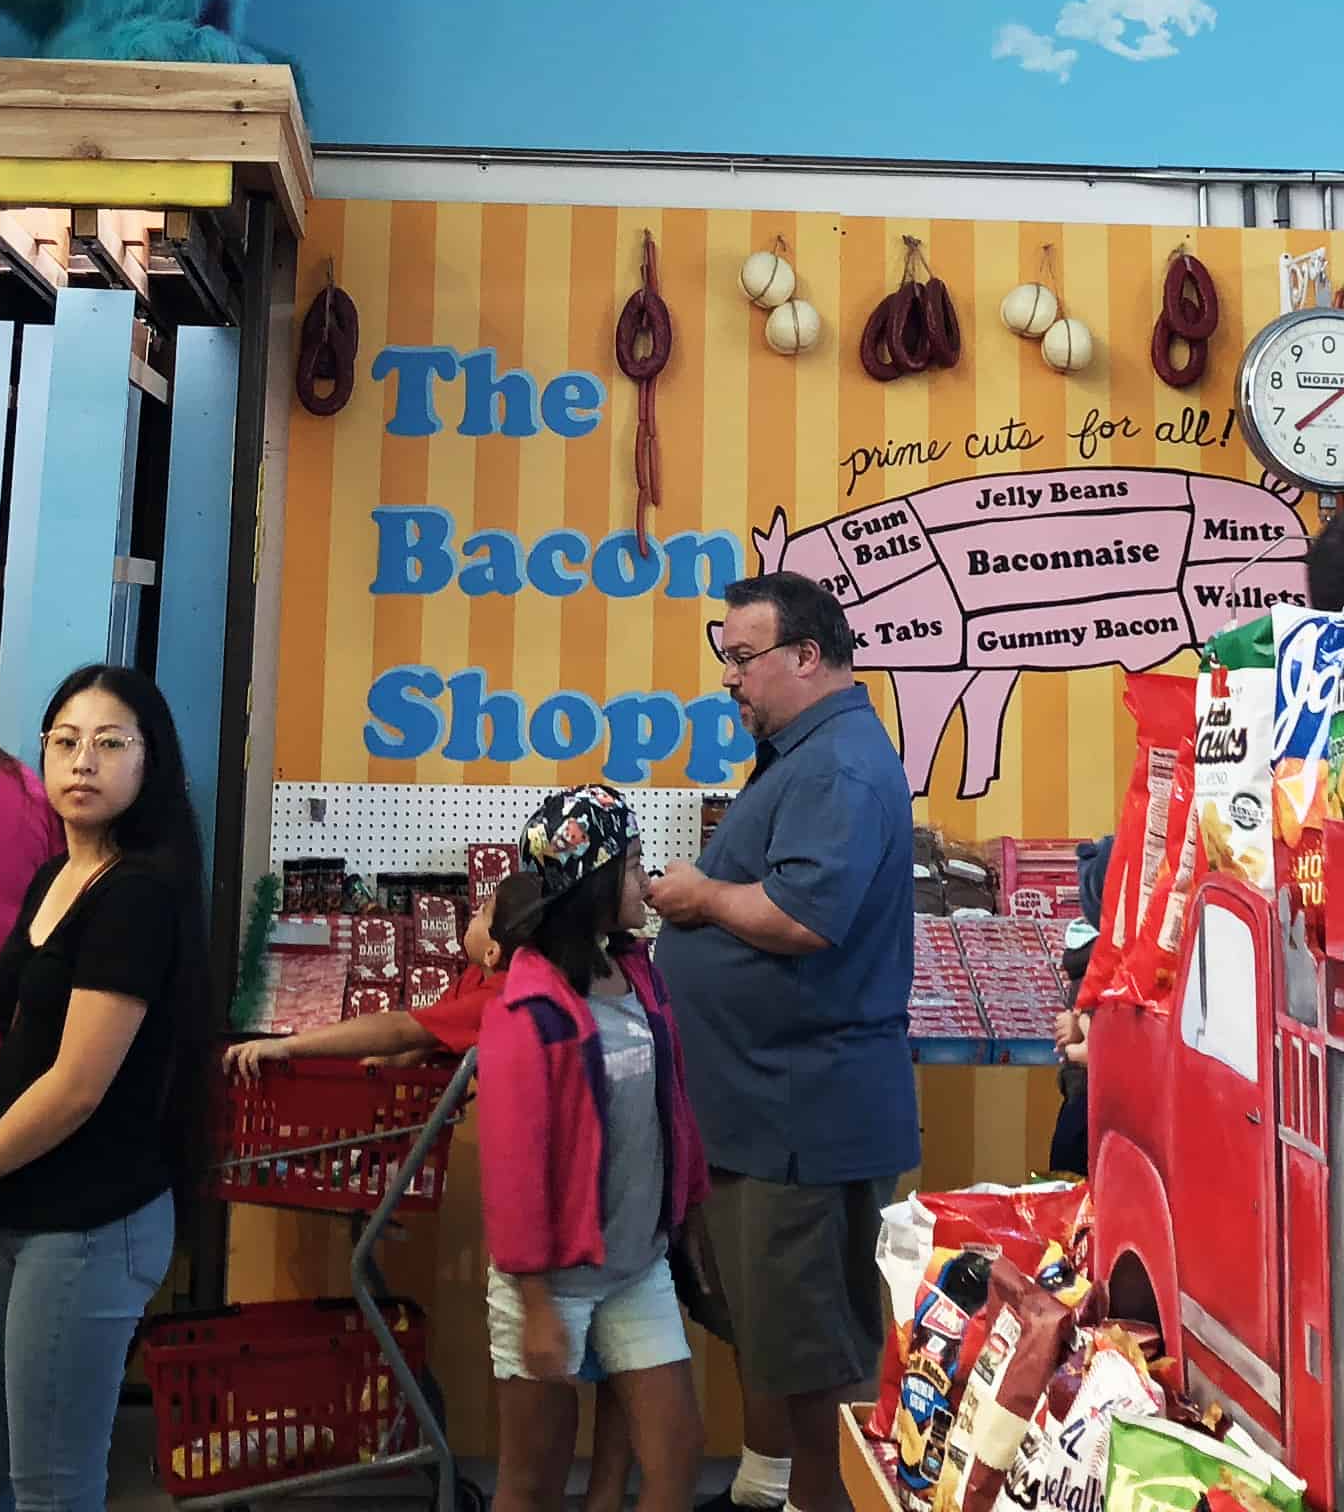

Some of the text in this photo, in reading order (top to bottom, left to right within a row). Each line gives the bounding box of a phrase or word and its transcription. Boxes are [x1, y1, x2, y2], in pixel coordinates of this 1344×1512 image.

[1291, 344, 1303, 363] 9
[1321, 336, 1336, 354] 0
[371, 345, 607, 438] The
[1270, 371, 1283, 390] 8
[1272, 407, 1286, 426] 7
[840, 406, 1236, 497] prime cuts for all!
[1292, 436, 1306, 455] 6
[1325, 448, 1338, 467] 5
[975, 481, 1129, 510] Jelly Beans
[841, 509, 908, 541] Gum
[1203, 518, 1286, 542] Mints
[369, 504, 744, 599] Bacon
[853, 534, 922, 566] Balls
[966, 539, 1160, 576] Baconnaise
[1193, 585, 1306, 609] Wallets
[875, 618, 943, 645] Tabs
[977, 616, 1179, 653] Gummy Bacon
[362, 664, 758, 784] Shopp
[476, 882, 498, 896] BAC
